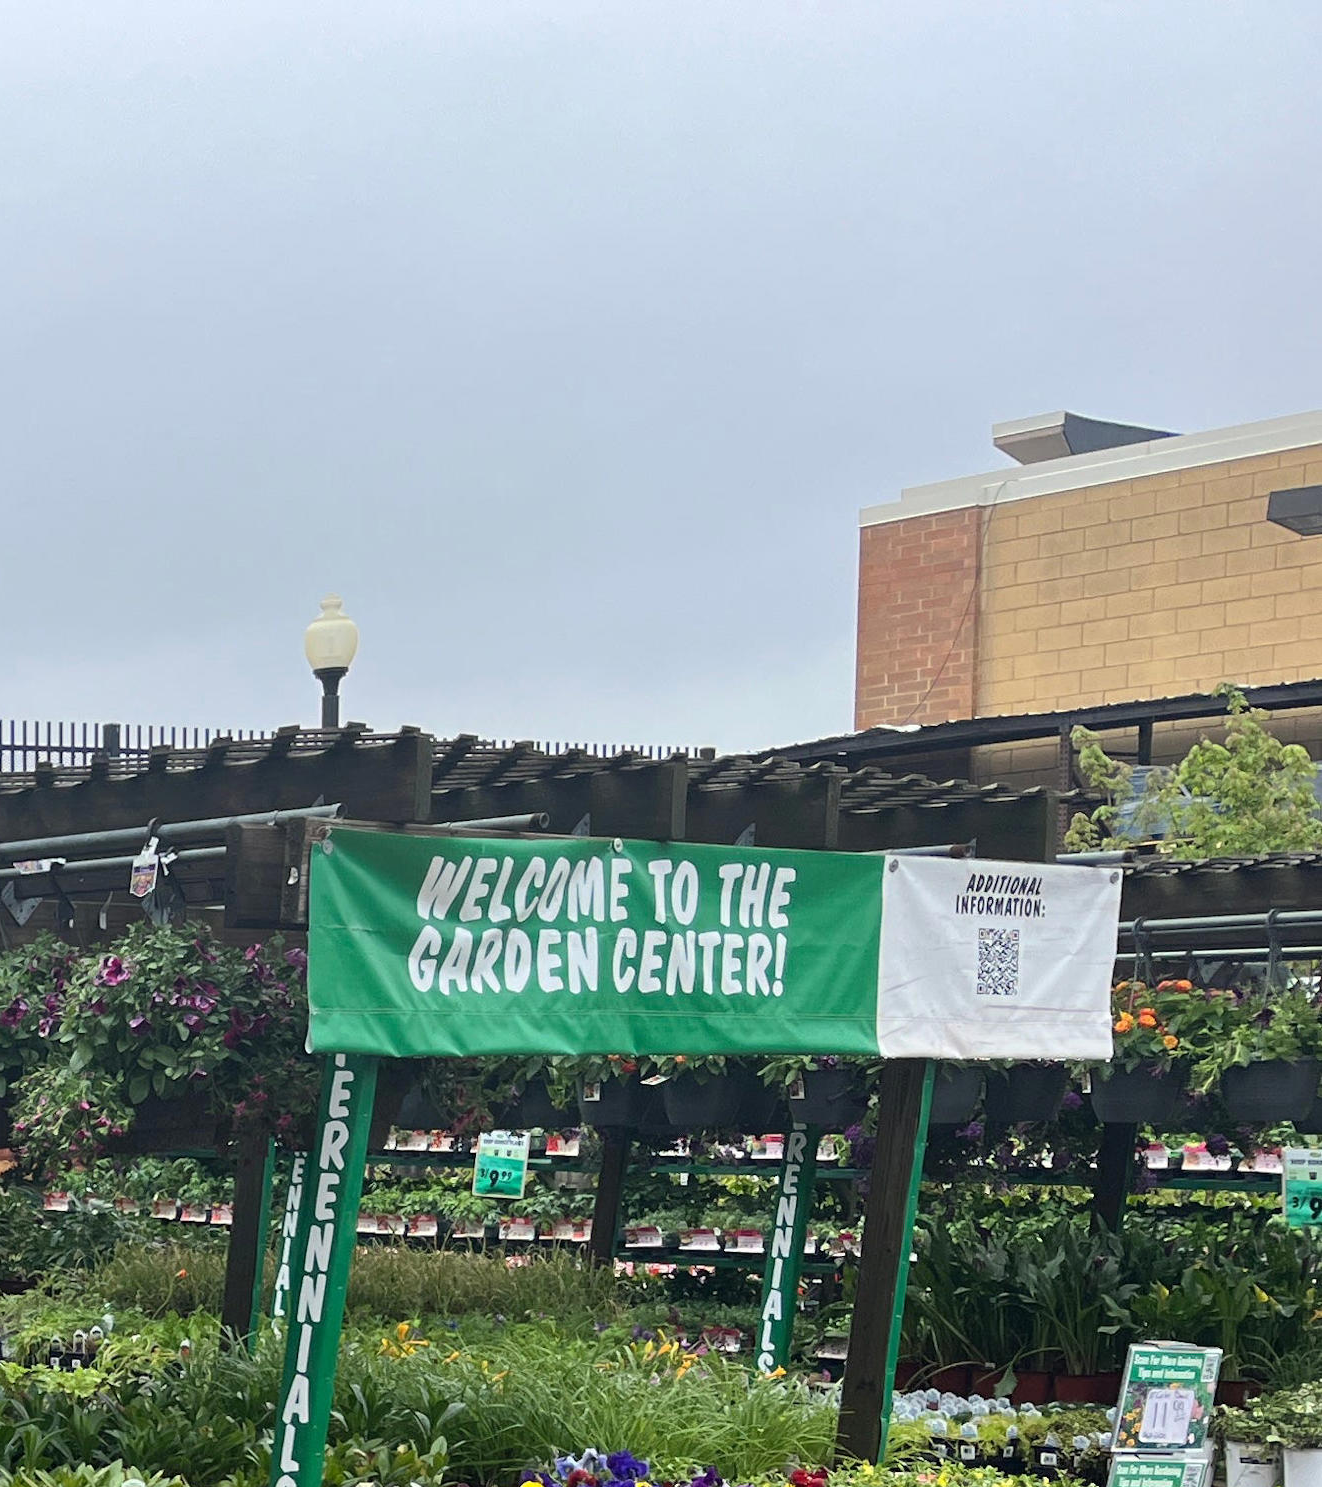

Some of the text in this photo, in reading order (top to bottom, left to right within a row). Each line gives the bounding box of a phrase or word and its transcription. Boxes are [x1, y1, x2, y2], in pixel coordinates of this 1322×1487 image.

[417, 855, 797, 929] WELCOME TO THE
[955, 895, 1046, 918] INFORMATION:
[966, 874, 1043, 895] ADDITIONAL
[407, 925, 788, 998] GARDEN CENTER!
[271, 1151, 308, 1340] ENNIALS
[757, 1122, 807, 1376] RENNIALS
